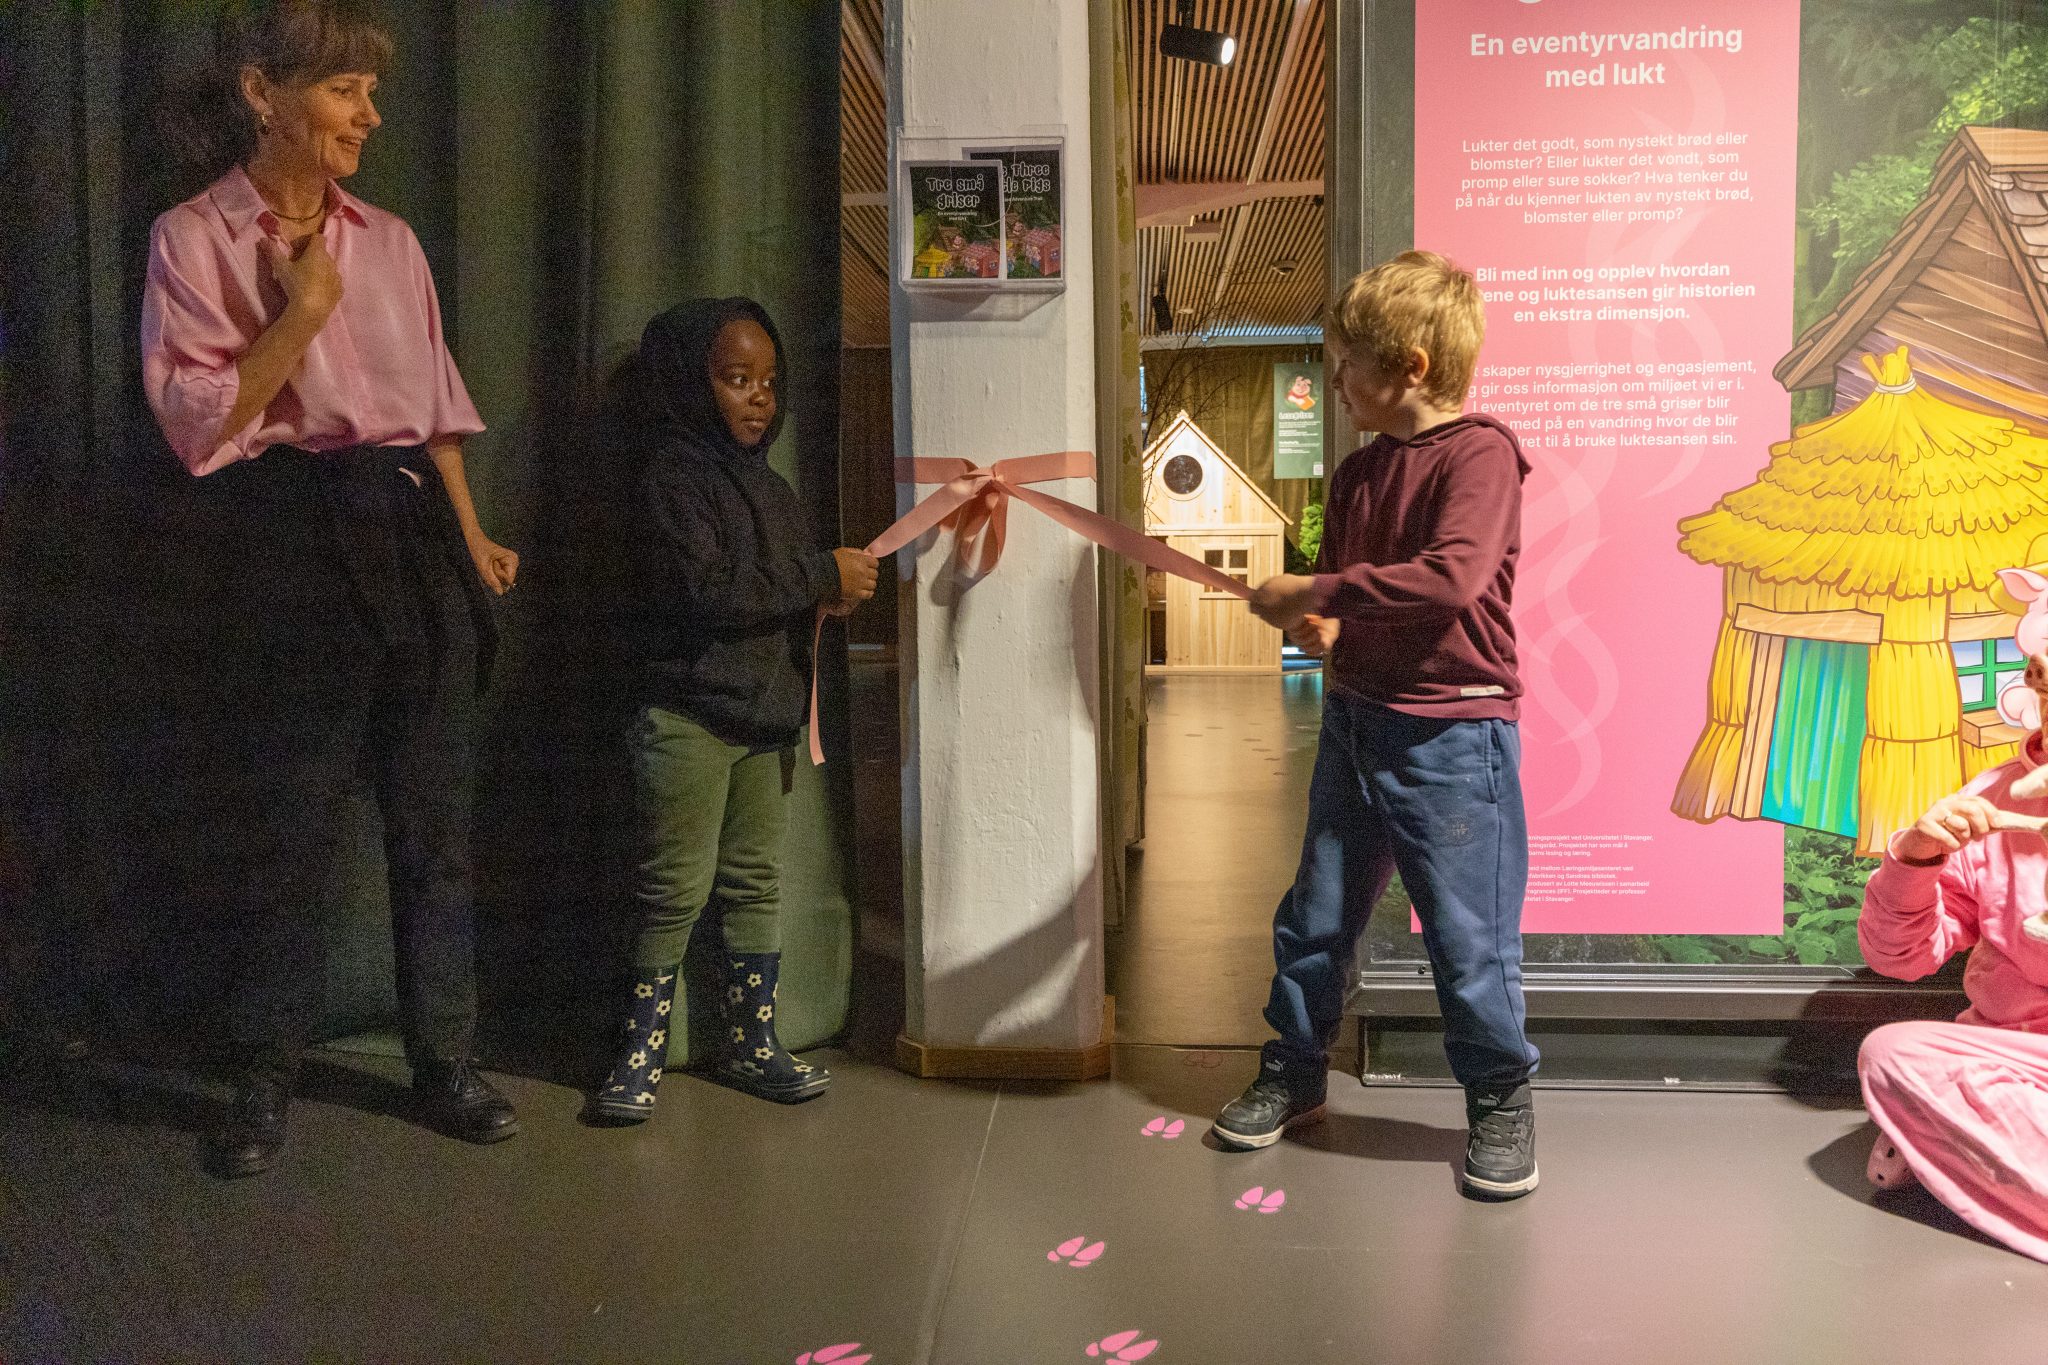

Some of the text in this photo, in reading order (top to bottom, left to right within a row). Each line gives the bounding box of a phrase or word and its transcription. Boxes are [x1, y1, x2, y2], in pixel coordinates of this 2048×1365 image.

[1471, 25, 1742, 57] En eventyrvandring
[1546, 62, 1665, 88] med lukt
[1463, 132, 1748, 153] Lukter det godt, som nystekt brød eller
[1011, 162, 1050, 177] Three
[1471, 153, 1738, 170] blomster? Eller lukter det vondt, som
[926, 174, 984, 192] Tre små
[1462, 169, 1748, 192] promp eller sure sokker? Hva tenker du
[937, 192, 980, 210] griser
[1455, 187, 1753, 210] på når du kjenner lukten av nystekt brød,
[1524, 208, 1683, 224] blomster eller promp?
[1476, 262, 1730, 282] Bli med inn og opplev hvordan
[1518, 290, 1540, 304] og
[1544, 287, 1647, 300] luktesansen
[1652, 288, 1675, 301] gir
[1680, 284, 1755, 298] historien
[1514, 306, 1690, 322] en ekstra dimensjon.
[1482, 364, 1532, 379] skaper
[1536, 362, 1631, 378] nysgjerrighet
[1636, 364, 1654, 376] og
[1658, 360, 1756, 376] engasjement,
[1468, 377, 1744, 398] g gir oss informasjon om miljøet vi er i.
[1480, 400, 1549, 415] eventyret
[1553, 402, 1576, 412] om
[1580, 399, 1598, 411] de
[1603, 399, 1622, 410] tre
[1626, 396, 1656, 410] små
[1661, 399, 1703, 412] griser
[1707, 396, 1730, 408] blir
[1509, 417, 1540, 430] med
[1545, 415, 1562, 432] på
[1566, 419, 1584, 429] en
[1589, 416, 1652, 431] vandring
[1656, 416, 1688, 427] hvor
[1692, 414, 1711, 427] de
[1716, 414, 1738, 426] blir
[1545, 434, 1558, 447] til
[1562, 433, 1570, 447] å
[1575, 434, 1616, 447] bruke
[1620, 434, 1708, 446] luktesansen
[1712, 434, 1737, 444] sin.
